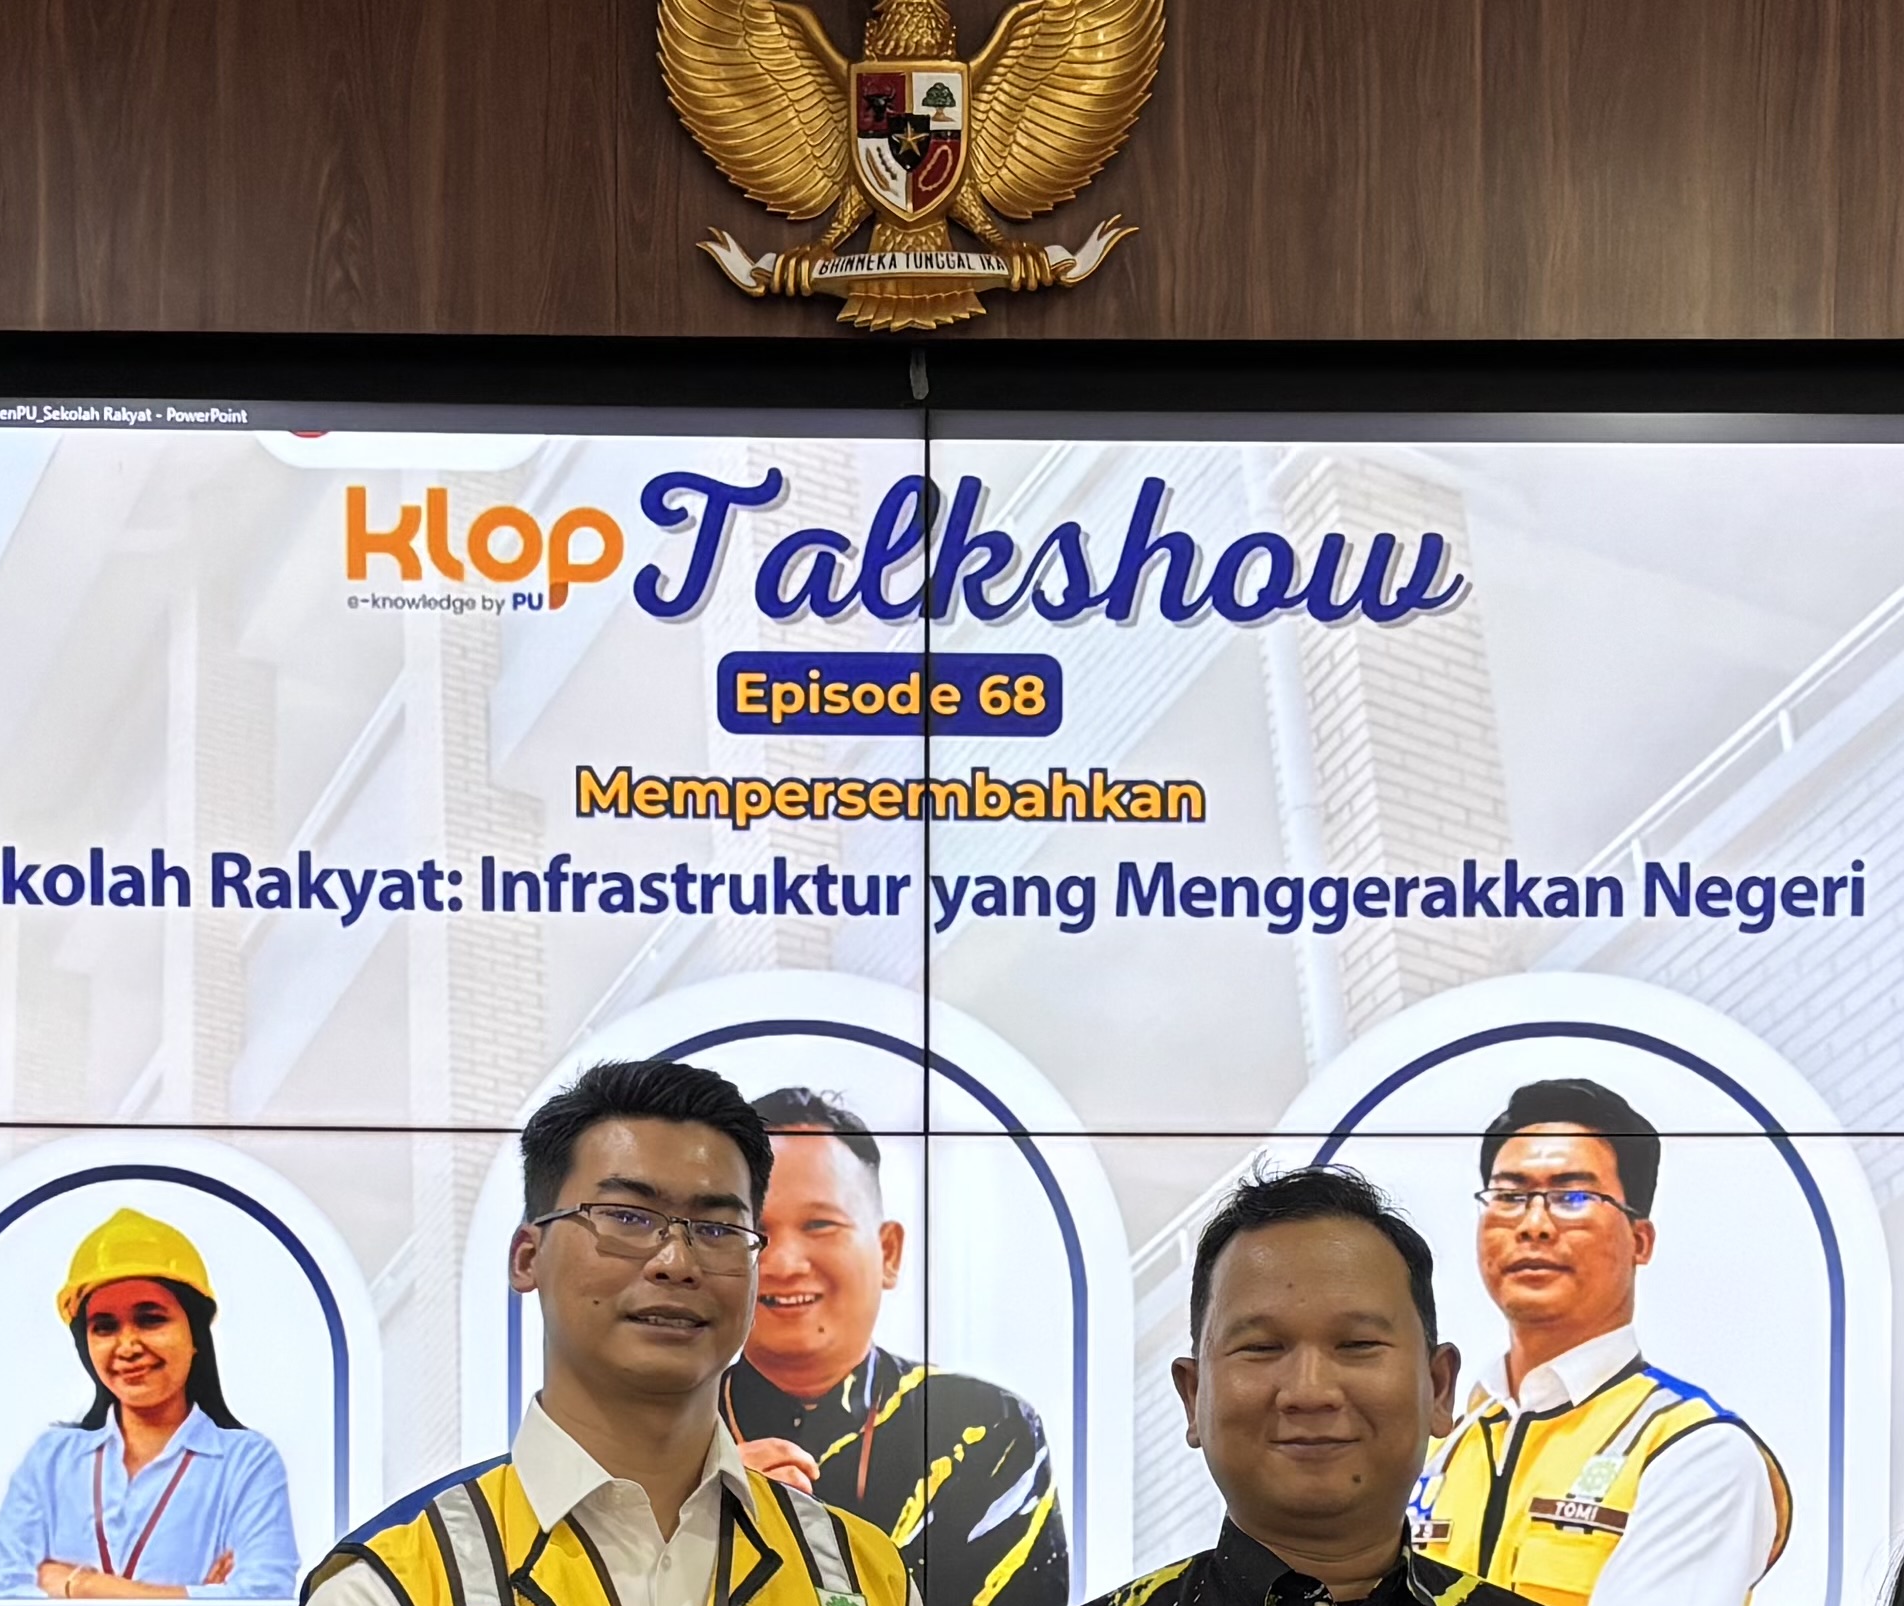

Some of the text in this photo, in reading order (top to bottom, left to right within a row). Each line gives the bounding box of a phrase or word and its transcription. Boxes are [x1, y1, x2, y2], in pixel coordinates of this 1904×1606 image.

[818, 252, 1006, 275] BHINNEKA TUNGGAL IKA
[103, 406, 152, 426] Rakyat
[167, 407, 248, 423] PowerPoint
[633, 467, 1466, 625] Talkshow
[347, 593, 543, 616] e-knowledge by PU
[734, 671, 1046, 721] Episode 68
[575, 765, 1207, 829] Mempersembahkan
[211, 850, 463, 929] Rakyat:
[481, 853, 912, 917] Infrastruktur
[933, 874, 1096, 935] yang
[1115, 858, 1624, 935] Menggerakkan
[1643, 858, 1865, 935] Negeri
[1554, 1501, 1599, 1520] TOMI
